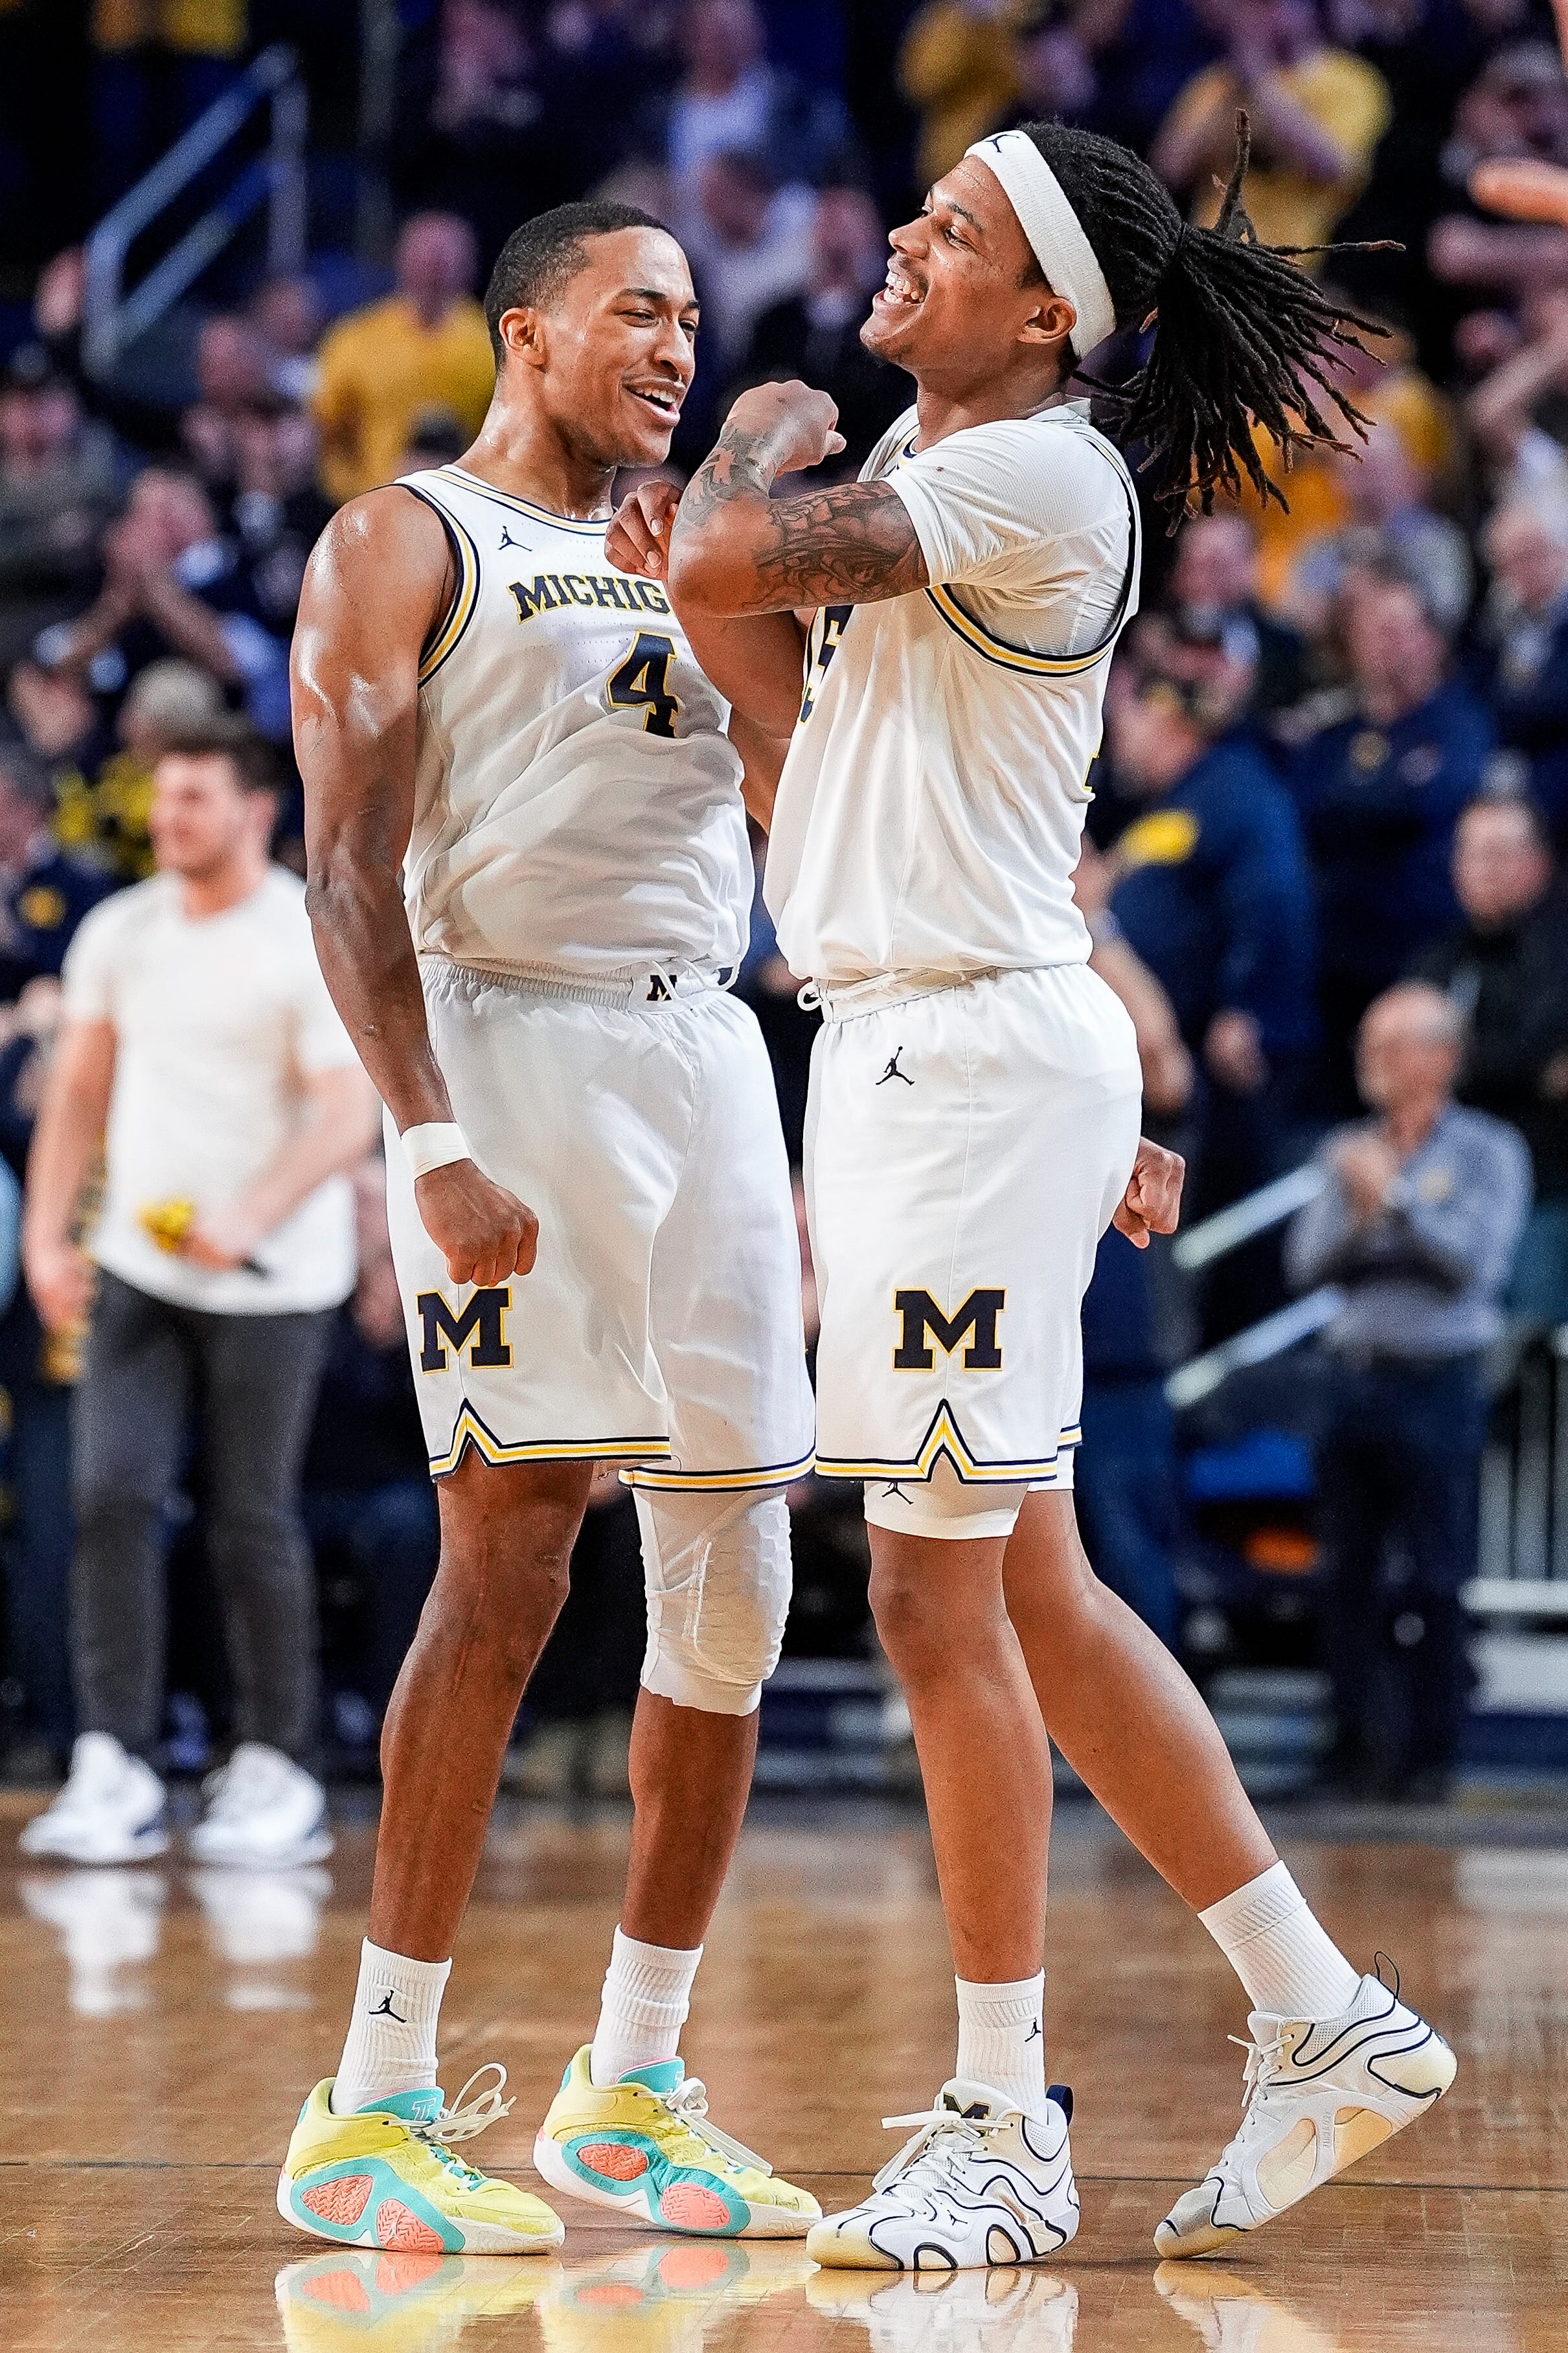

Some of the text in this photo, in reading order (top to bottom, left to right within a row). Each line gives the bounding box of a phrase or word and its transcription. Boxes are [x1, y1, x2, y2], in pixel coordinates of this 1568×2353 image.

[506, 574, 673, 625] MICHIG
[606, 630, 681, 739] 4
[416, 1286, 514, 1374] M
[892, 1287, 1008, 1372] M
